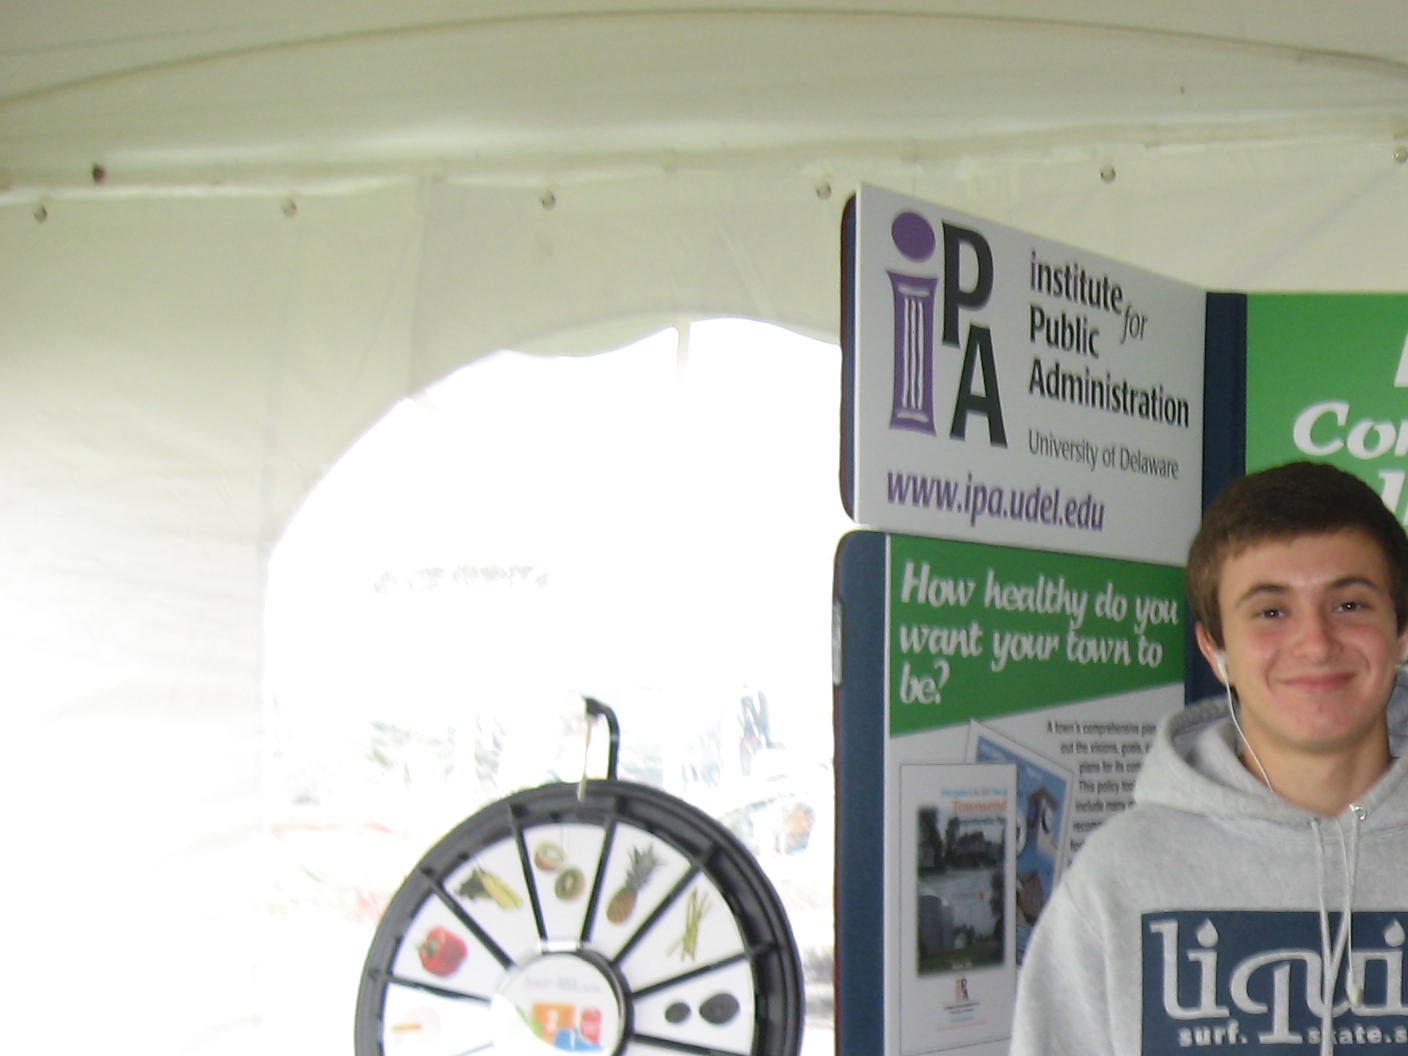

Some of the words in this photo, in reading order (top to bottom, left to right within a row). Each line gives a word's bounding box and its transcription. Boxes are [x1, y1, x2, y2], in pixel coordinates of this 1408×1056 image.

[1029, 250, 1124, 315] institute
[1029, 304, 1100, 359] Public
[1120, 304, 1148, 345] for
[1028, 357, 1190, 428] Administration
[1028, 428, 1098, 472] University
[1101, 444, 1117, 468] of
[1119, 448, 1180, 481] Delaware
[887, 470, 1106, 532] www.ipa.udel.edu
[900, 559, 976, 608] How
[984, 566, 1089, 631] healthy
[1094, 582, 1128, 622] do
[1134, 596, 1179, 635] you
[900, 620, 983, 659] want
[991, 630, 1060, 673] your
[1066, 620, 1132, 666] town
[1137, 634, 1164, 669] to
[900, 660, 950, 705] be?
[1178, 1019, 1248, 1048] surf.
